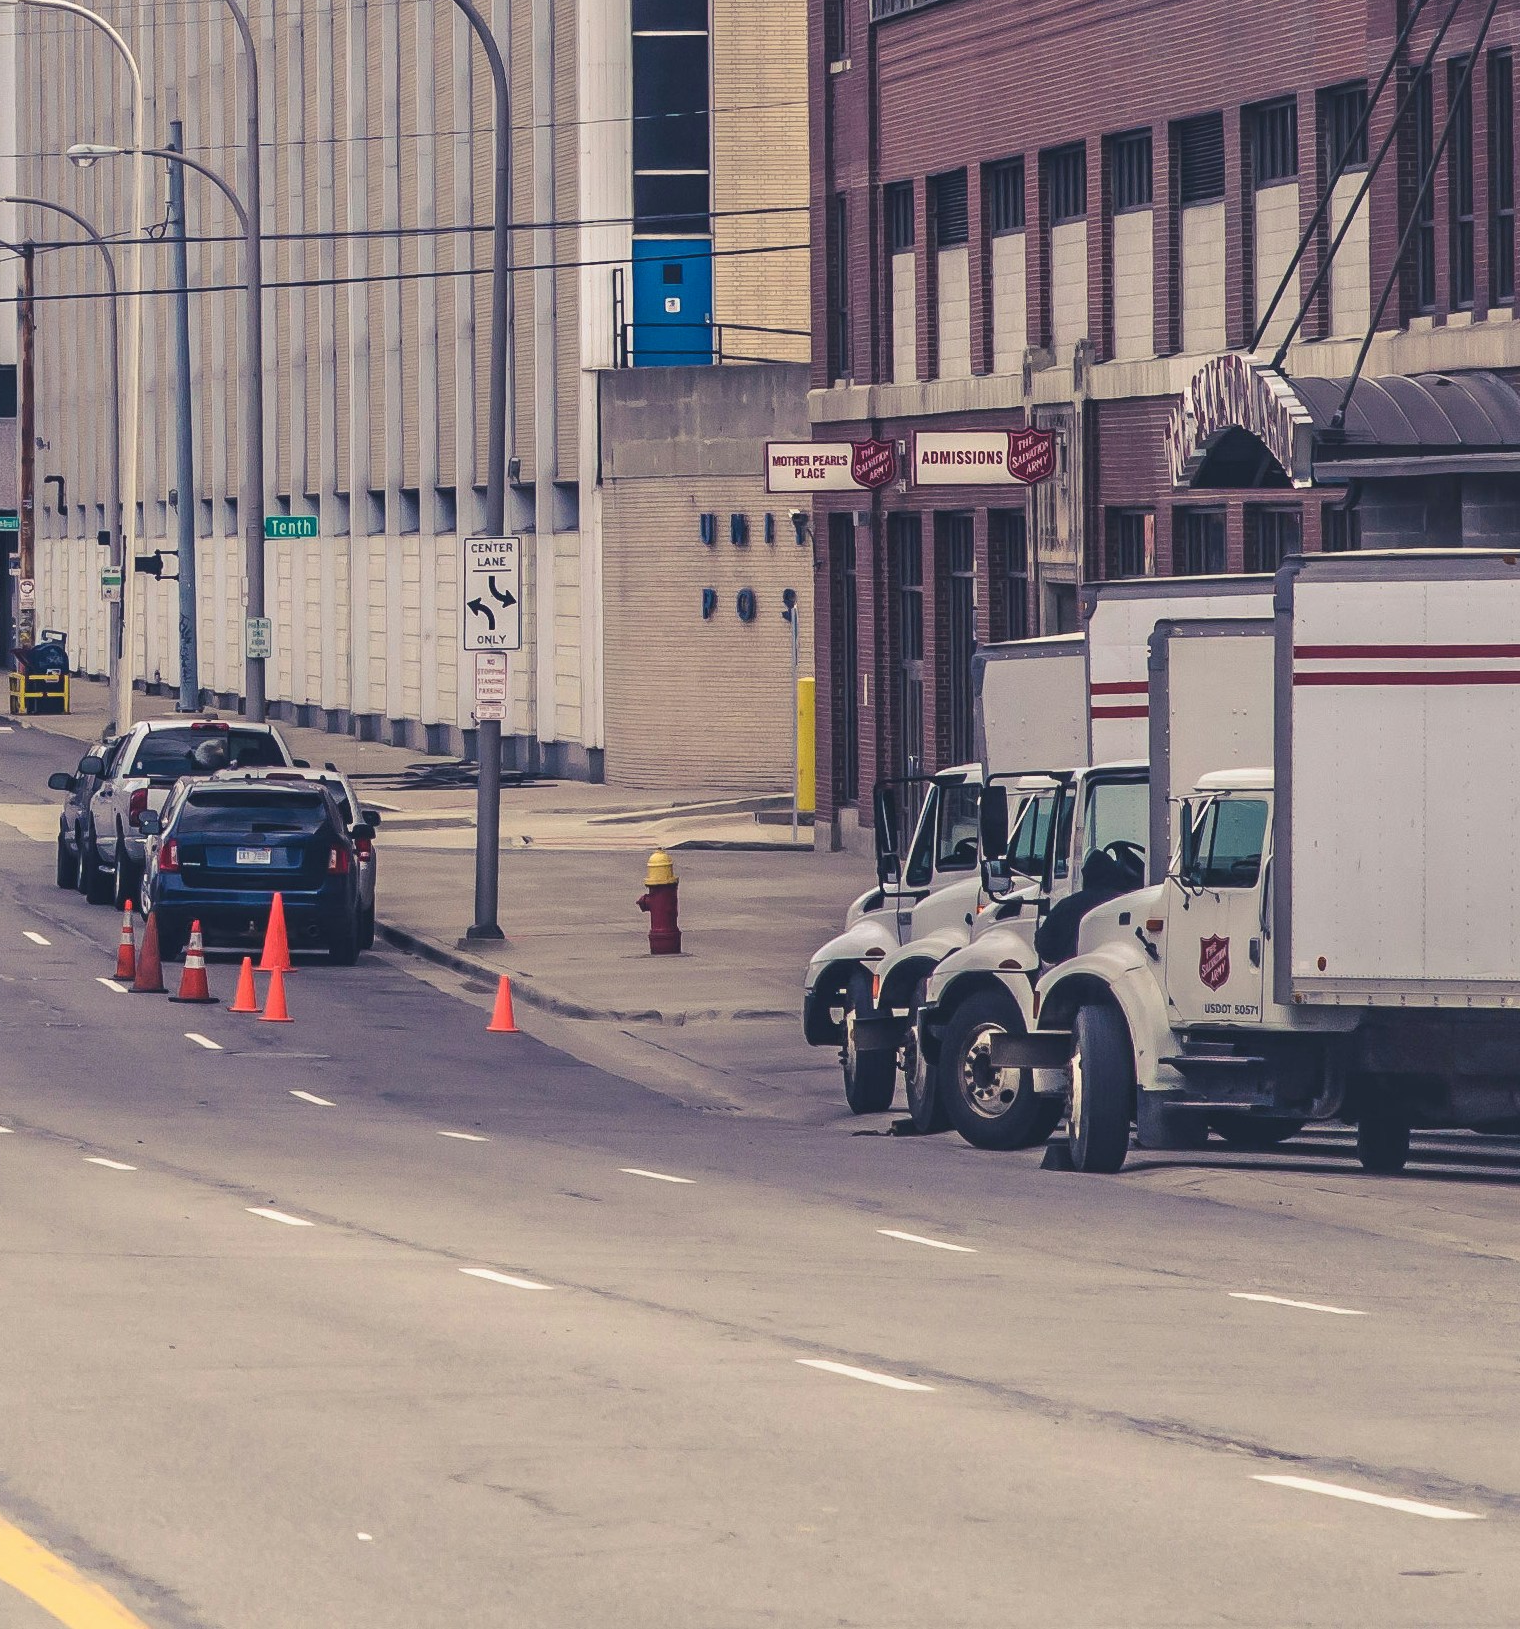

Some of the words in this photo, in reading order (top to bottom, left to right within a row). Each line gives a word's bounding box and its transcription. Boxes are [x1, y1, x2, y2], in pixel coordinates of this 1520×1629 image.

[1017, 435, 1035, 451] THE
[861, 446, 876, 460] THE
[921, 450, 1003, 465] ADMISSIONS
[1011, 440, 1050, 470] SALVATION
[772, 455, 810, 467] MOTHER
[812, 454, 848, 467] PEARL'S
[855, 451, 890, 477] SALVATION
[1026, 455, 1050, 475] ARMY
[794, 468, 826, 479] PLACE
[868, 463, 890, 481] ARMY
[272, 519, 311, 535] Tenth
[471, 543, 513, 554] CENTER
[477, 557, 506, 567] LANE
[476, 635, 507, 645] ONLY
[486, 658, 496, 666] NO
[477, 668, 506, 676] STOPPING
[477, 677, 505, 686] STANDING
[1204, 1003, 1232, 1014] USDOT
[1234, 1004, 1259, 1016] 50571
